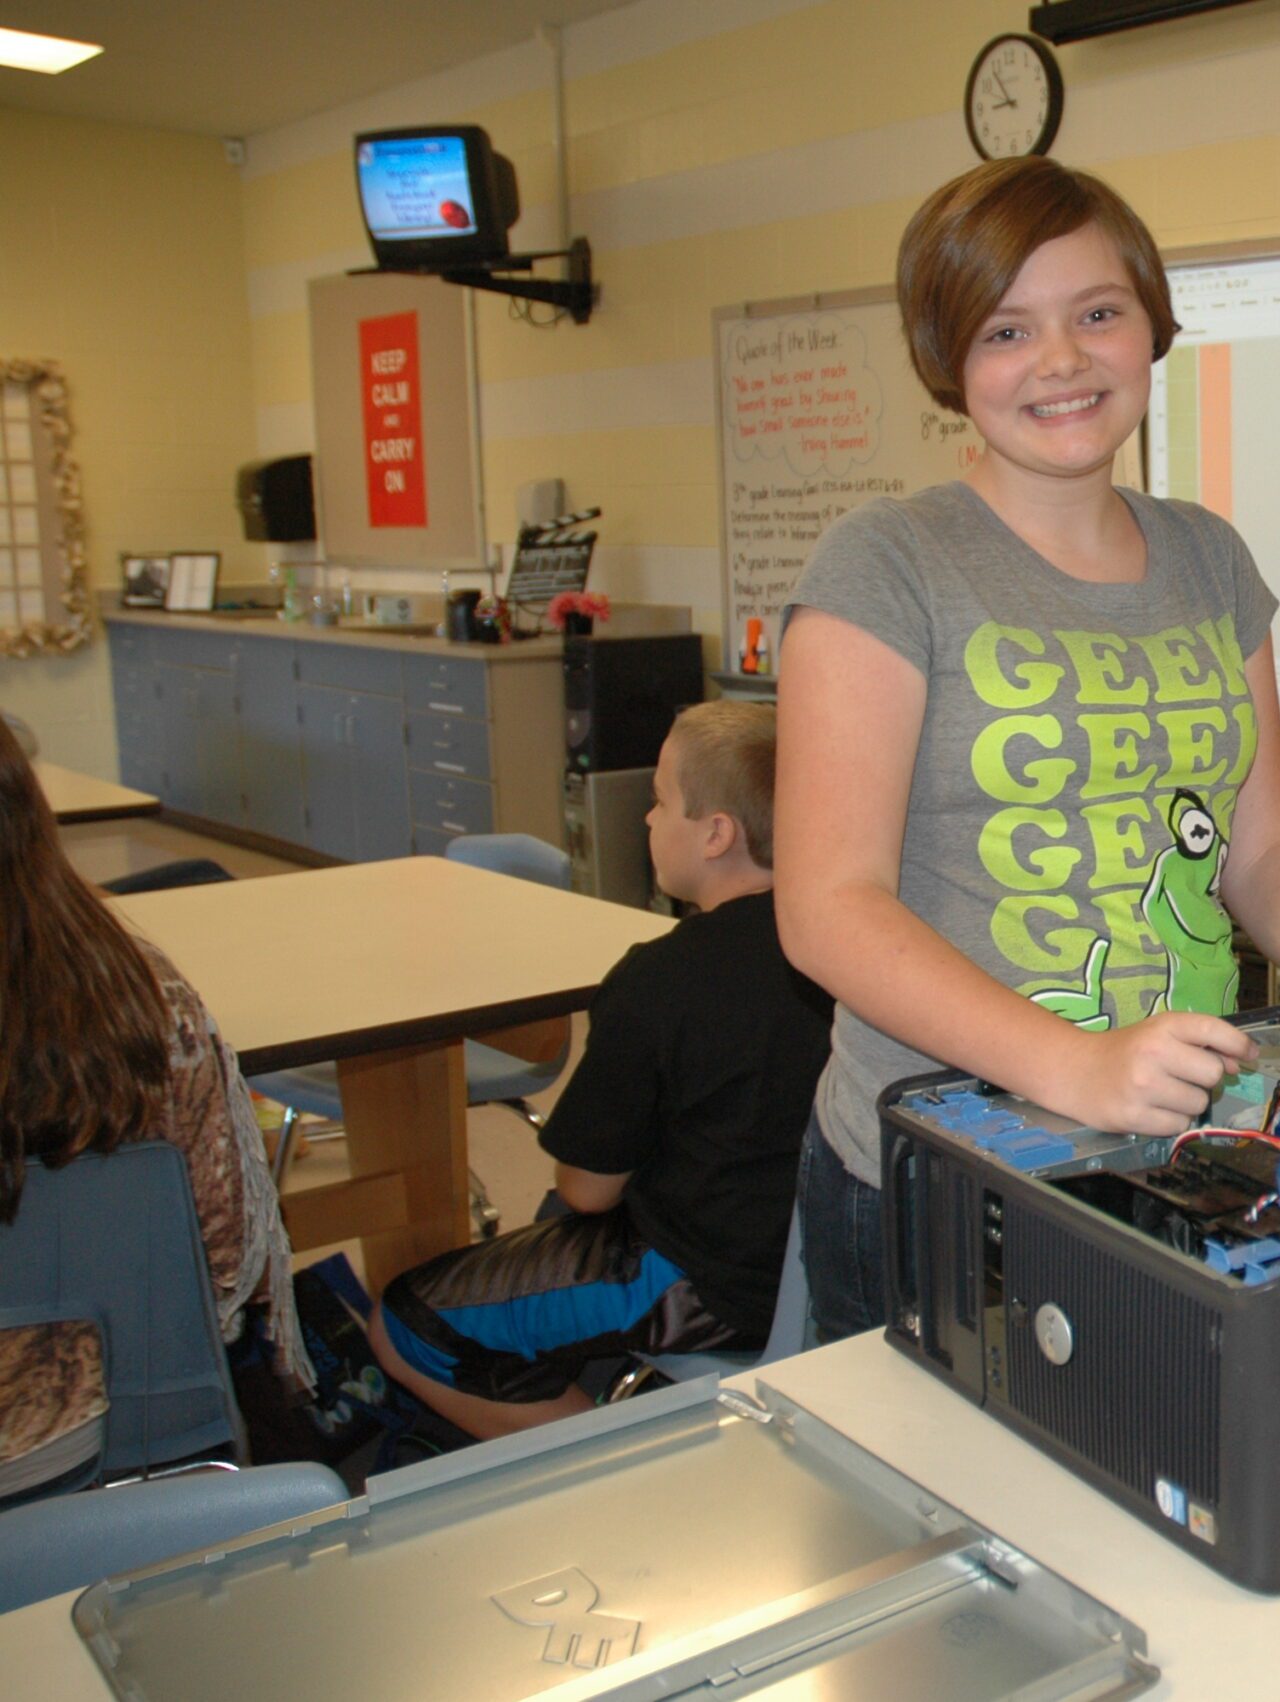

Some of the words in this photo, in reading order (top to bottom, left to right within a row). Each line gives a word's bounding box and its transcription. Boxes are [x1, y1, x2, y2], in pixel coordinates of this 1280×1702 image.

[1003, 48, 1015, 66] 12
[1023, 50, 1029, 67] 1
[1034, 65, 1041, 81] 2
[982, 79, 992, 94] 10
[976, 102, 983, 117] 9
[983, 121, 989, 137] 8
[1026, 129, 1032, 145] 5
[994, 136, 1000, 151] 7
[1010, 138, 1017, 154] 6
[736, 336, 767, 365] Quote
[772, 331, 783, 363] of
[371, 349, 406, 375] KEEP
[372, 381, 409, 408] CALM
[371, 438, 415, 463] CARRY
[385, 469, 405, 493] ON
